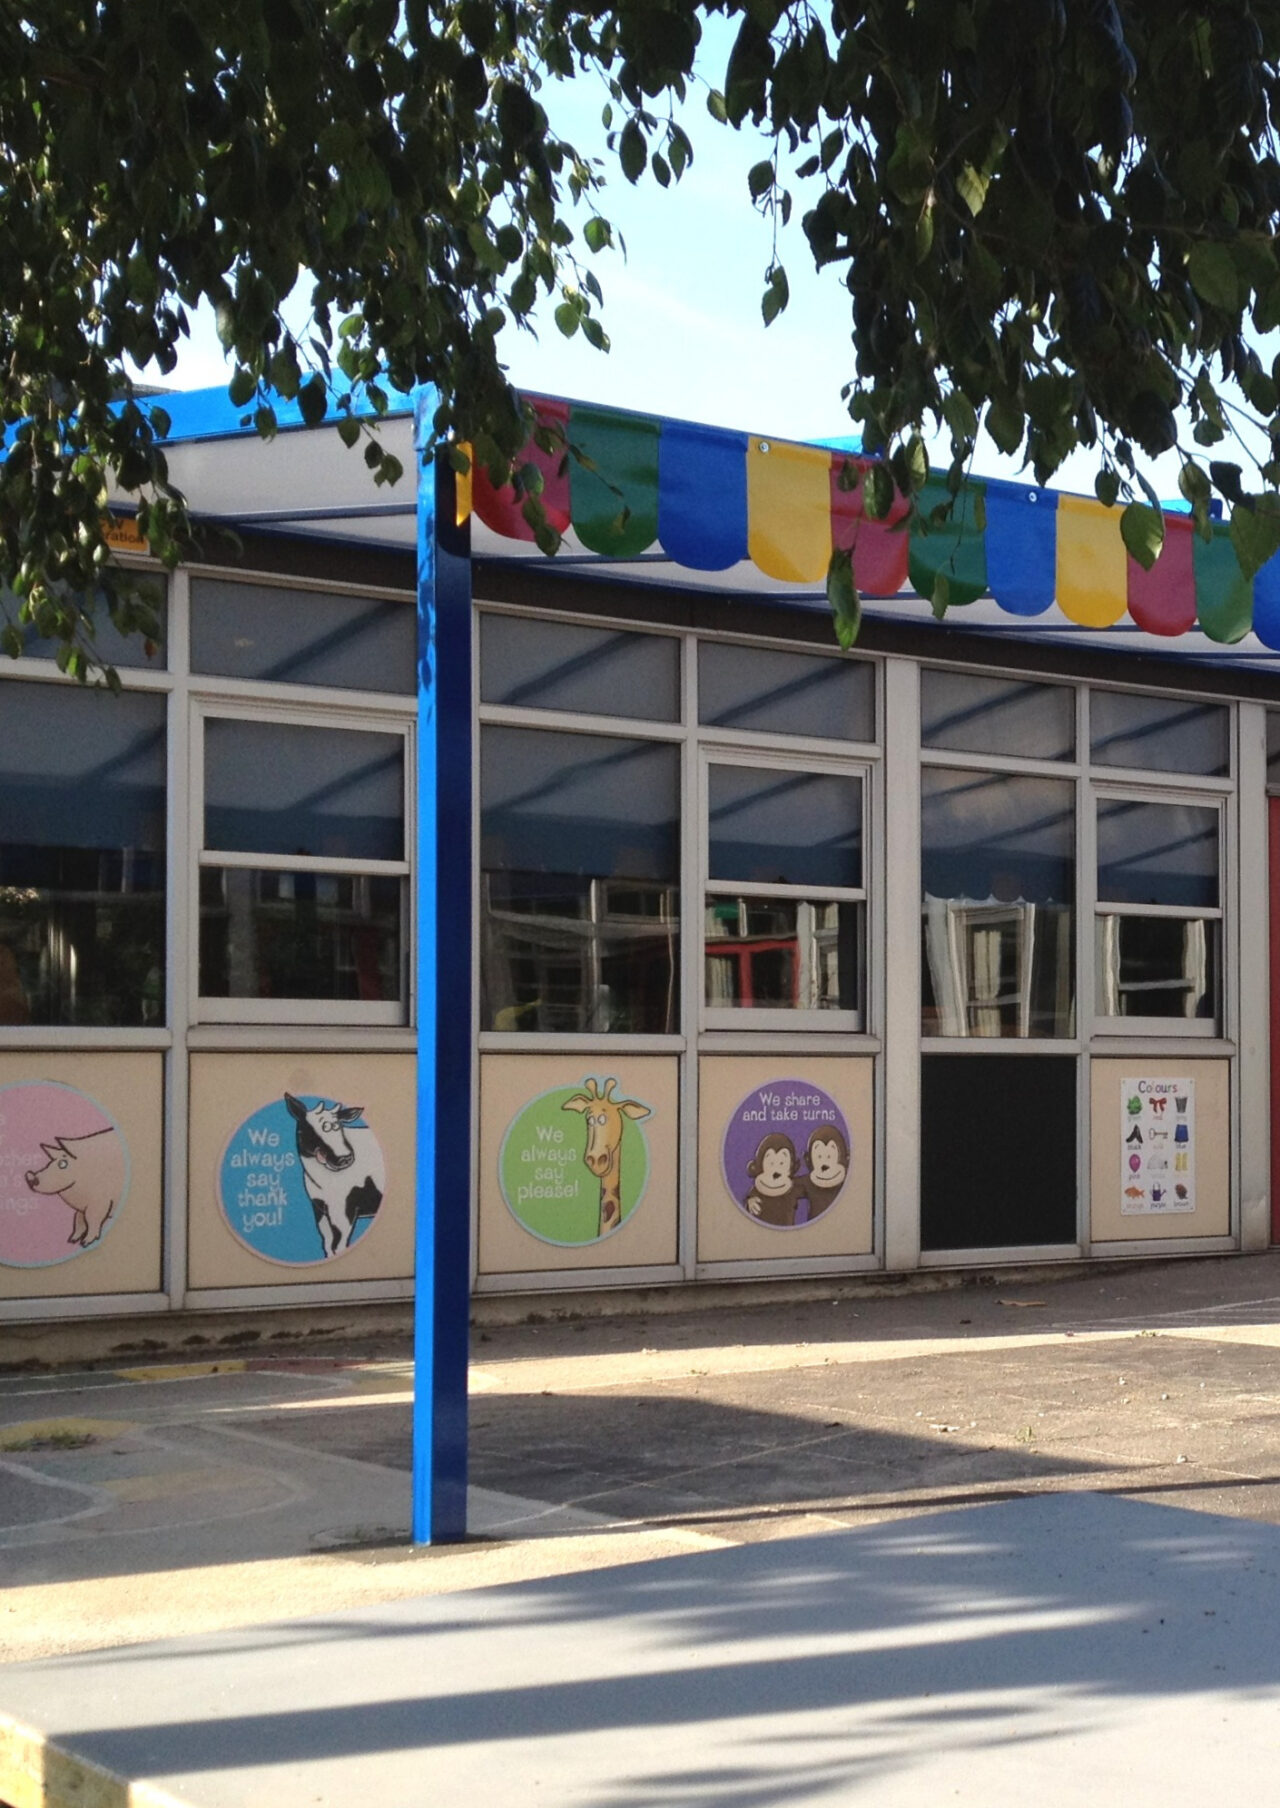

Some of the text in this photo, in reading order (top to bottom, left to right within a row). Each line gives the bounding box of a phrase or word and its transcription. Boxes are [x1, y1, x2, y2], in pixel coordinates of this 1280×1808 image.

[1138, 1080, 1178, 1094] Colours
[759, 1091, 820, 1106] We share
[743, 1106, 836, 1121] and take turns
[248, 1127, 281, 1147] We
[536, 1126, 565, 1143] We
[231, 1148, 296, 1172] always
[521, 1144, 577, 1166] always
[246, 1173, 280, 1192] say
[535, 1167, 565, 1185] say
[238, 1188, 288, 1207] thank
[517, 1179, 580, 1205] please!
[243, 1206, 283, 1232] you!
